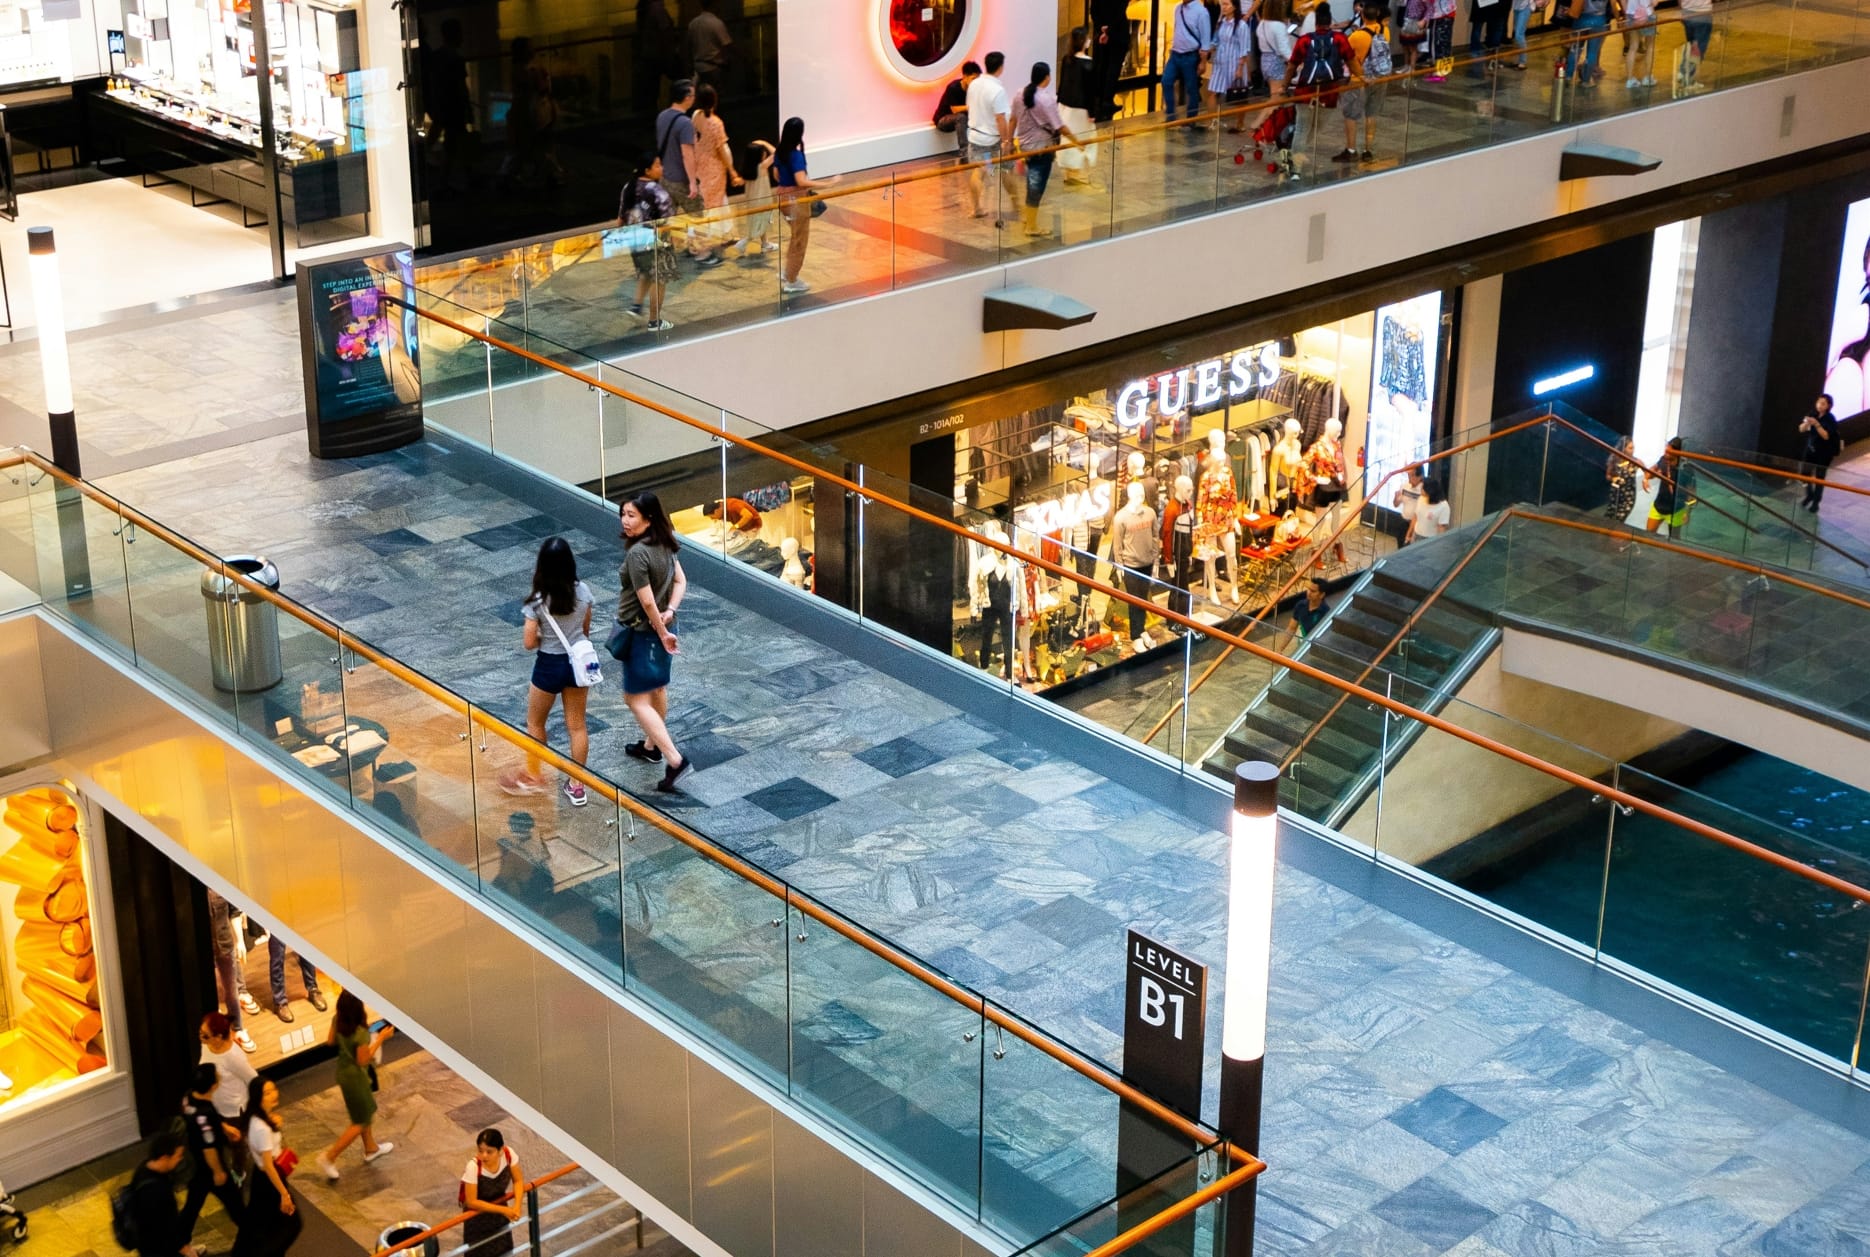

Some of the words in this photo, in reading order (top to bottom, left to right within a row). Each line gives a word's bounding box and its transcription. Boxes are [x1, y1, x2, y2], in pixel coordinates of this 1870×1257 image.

[322, 281, 336, 289] STEP
[338, 278, 353, 286] INTO
[355, 275, 363, 283] AN
[332, 284, 357, 293] DIGITAL
[1116, 341, 1280, 427] GUESS
[1027, 484, 1111, 534] XMAS
[1135, 942, 1194, 986] LEVEL
[1140, 976, 1184, 1040] B1
